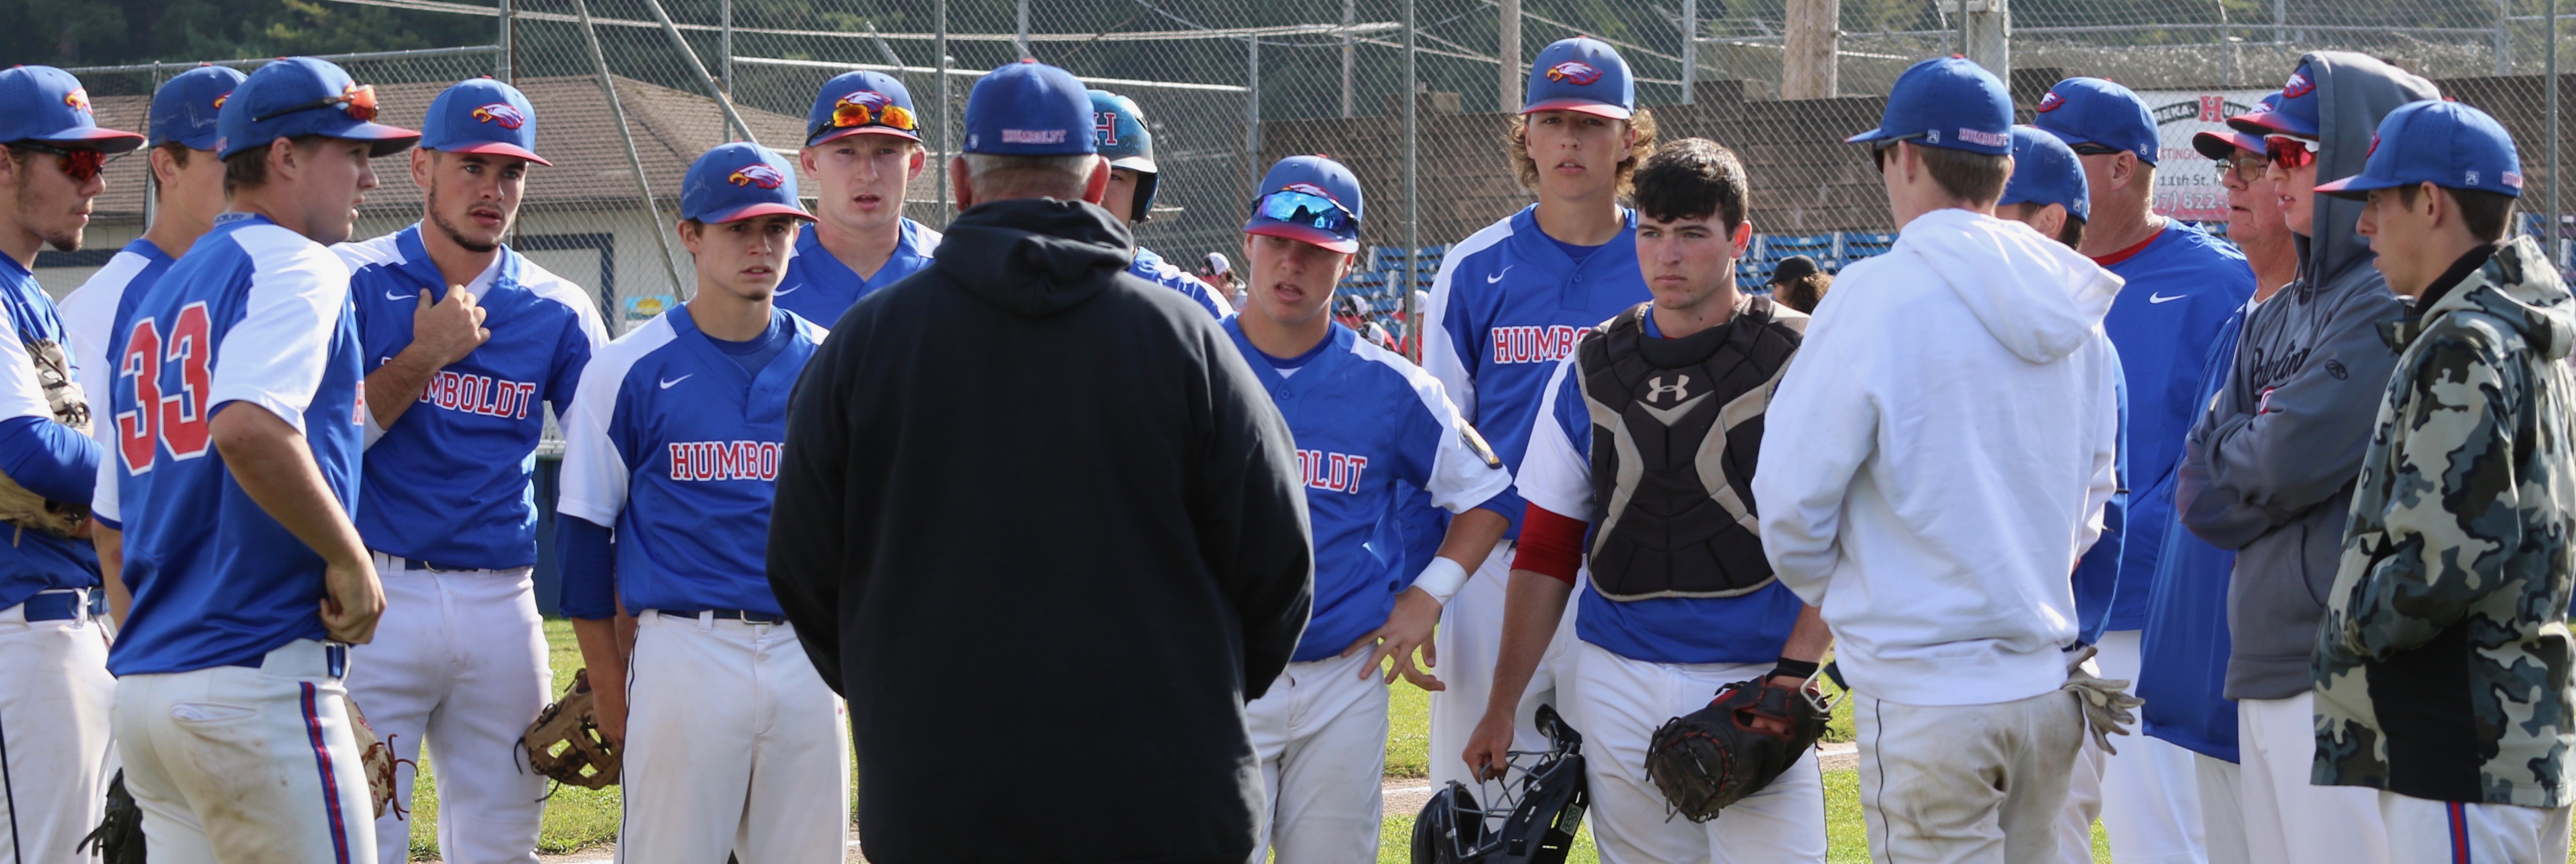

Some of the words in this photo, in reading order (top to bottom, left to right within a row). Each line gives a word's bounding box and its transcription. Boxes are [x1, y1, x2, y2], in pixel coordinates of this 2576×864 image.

[1001, 129, 1067, 144] HUMBOLDT
[2160, 174, 2189, 186] 11th
[2193, 174, 2209, 186] St.
[117, 300, 213, 477] 33
[419, 371, 536, 420] MBOLDT
[669, 440, 784, 481] HUMBO
